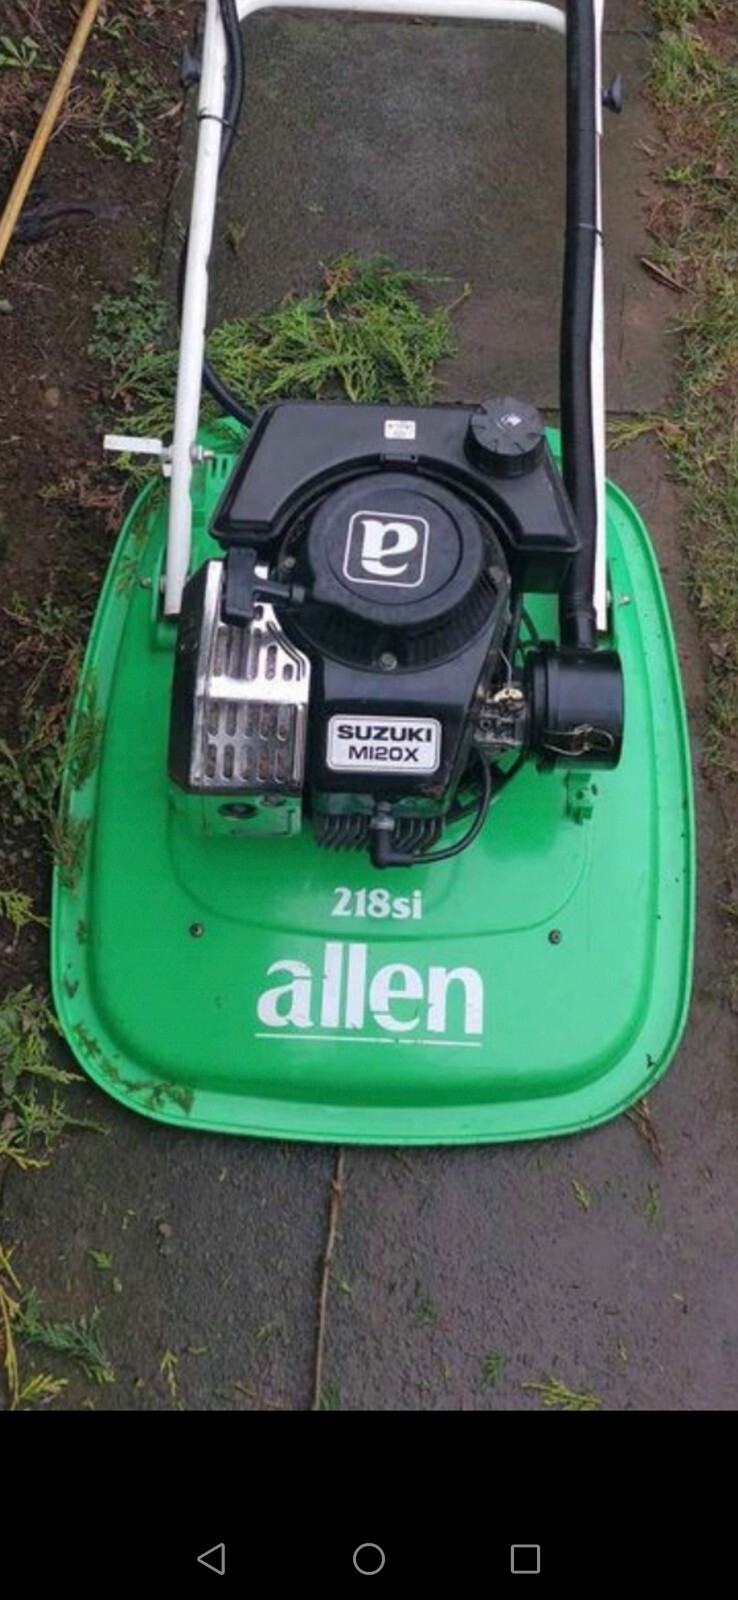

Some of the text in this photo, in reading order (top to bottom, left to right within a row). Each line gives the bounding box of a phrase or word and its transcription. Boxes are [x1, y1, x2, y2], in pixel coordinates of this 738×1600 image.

[336, 724, 433, 743] SUZUKI
[330, 886, 422, 920] 218si
[256, 941, 484, 1035] allen
